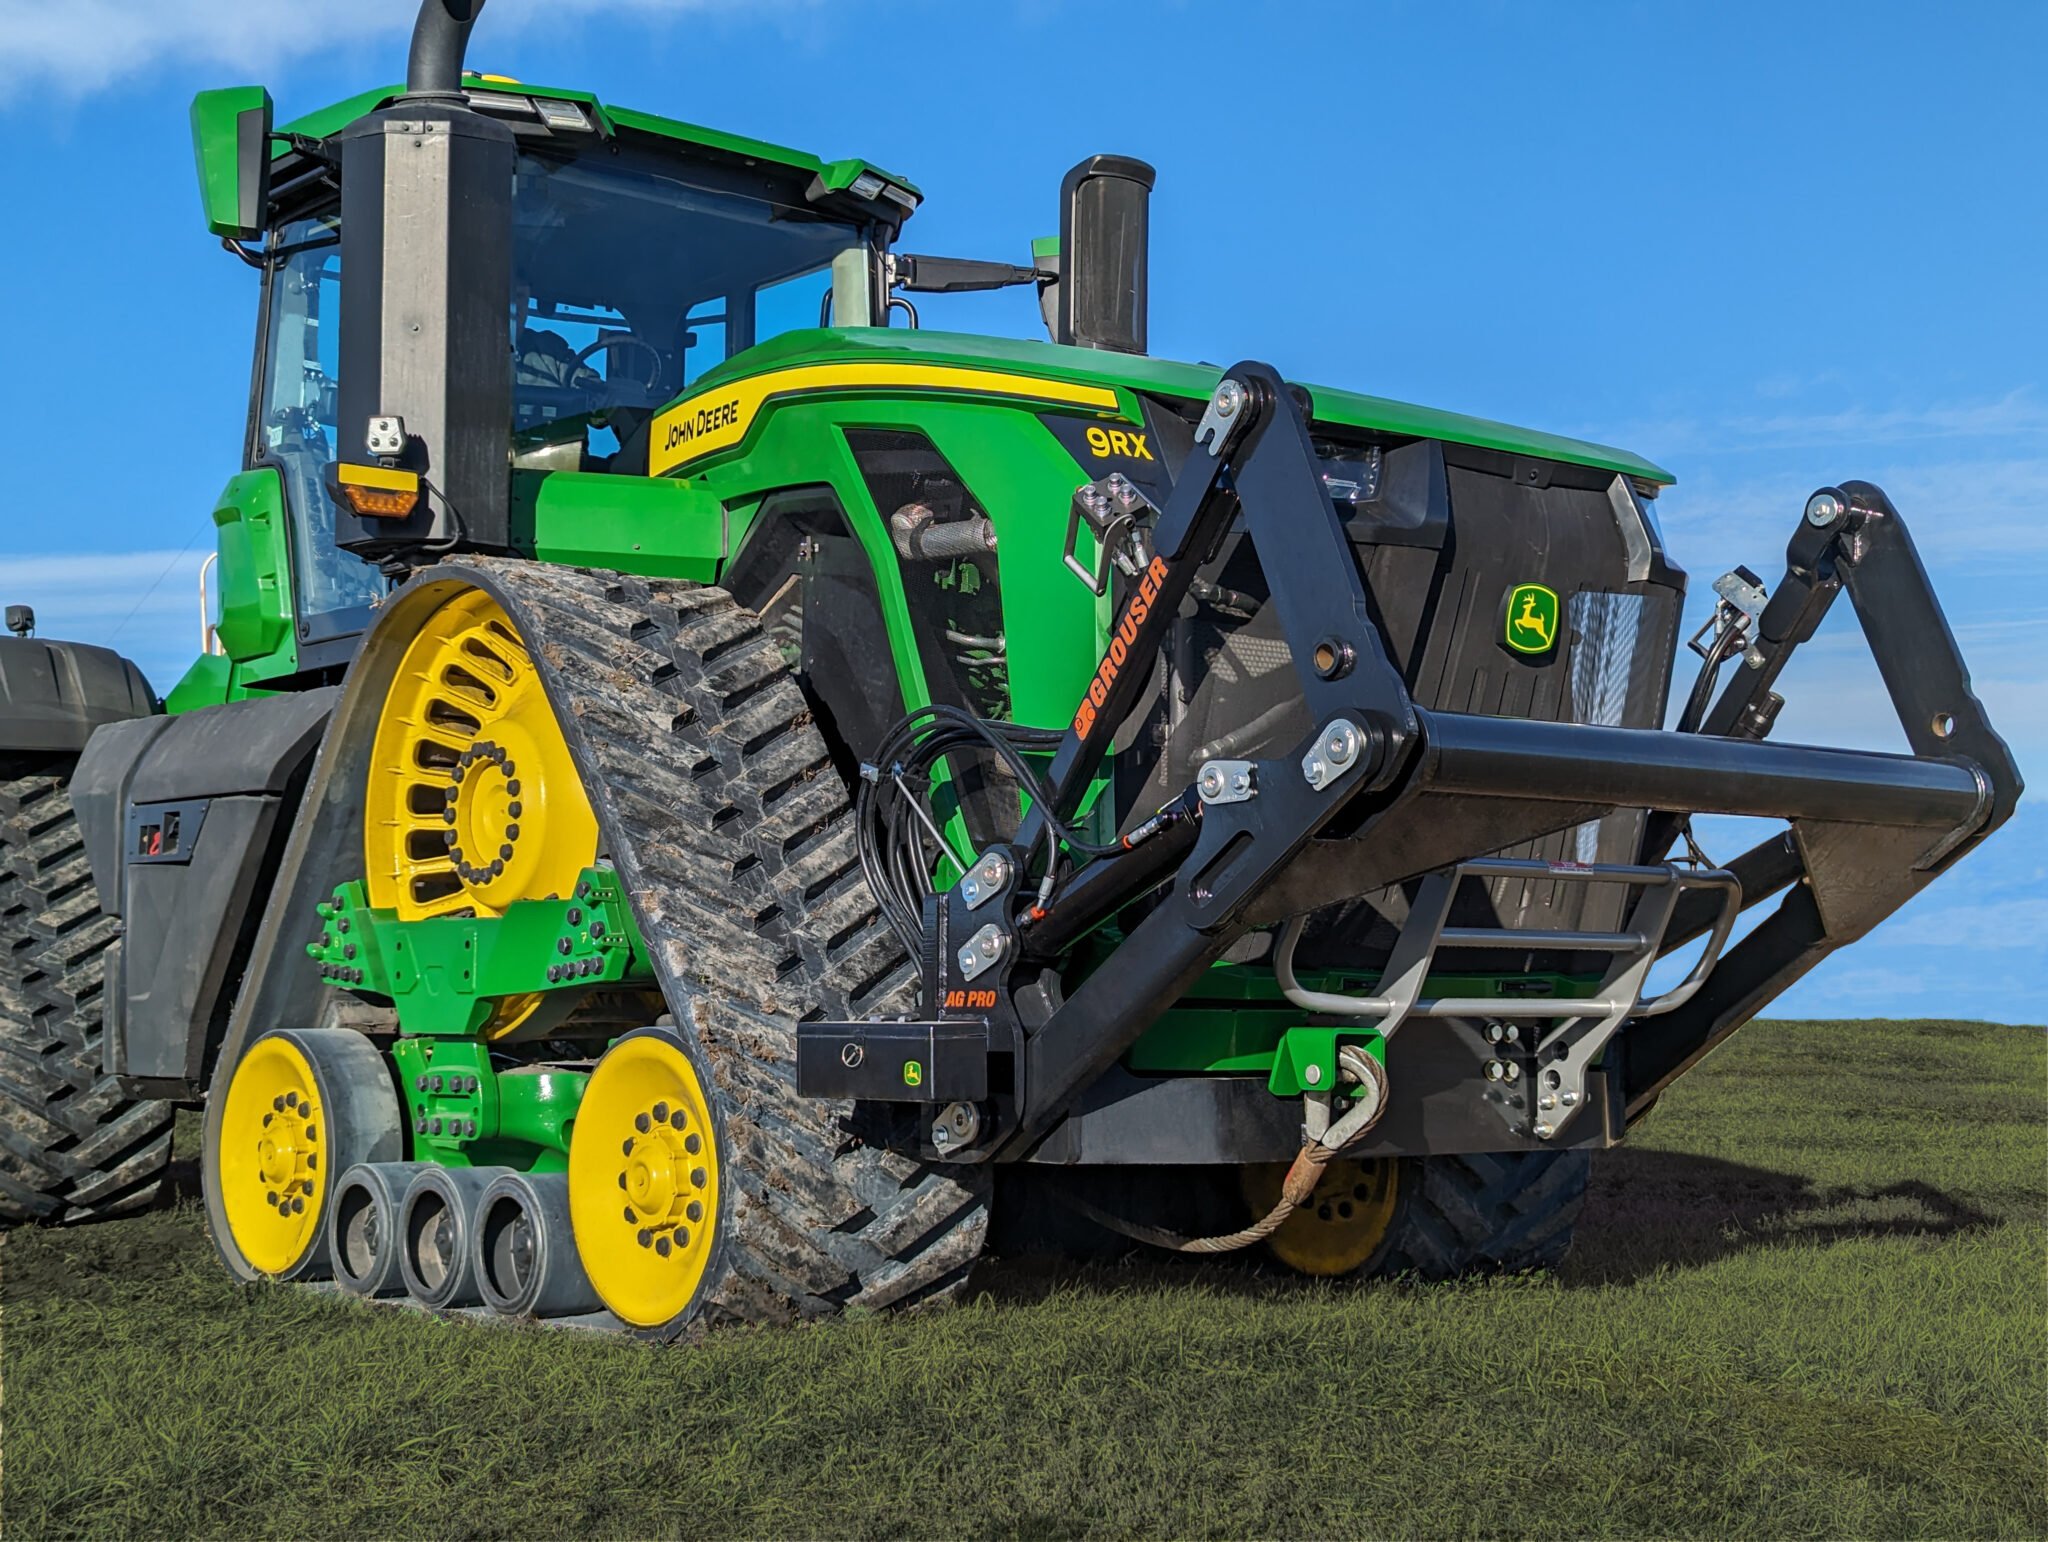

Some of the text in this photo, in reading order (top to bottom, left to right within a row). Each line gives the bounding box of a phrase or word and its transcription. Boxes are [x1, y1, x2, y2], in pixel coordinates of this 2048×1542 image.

[664, 400, 739, 451] JOHN DEERE
[1086, 427, 1154, 460] 9RX
[1089, 555, 1169, 708] GROUSER
[944, 990, 996, 1008] AG PRO
